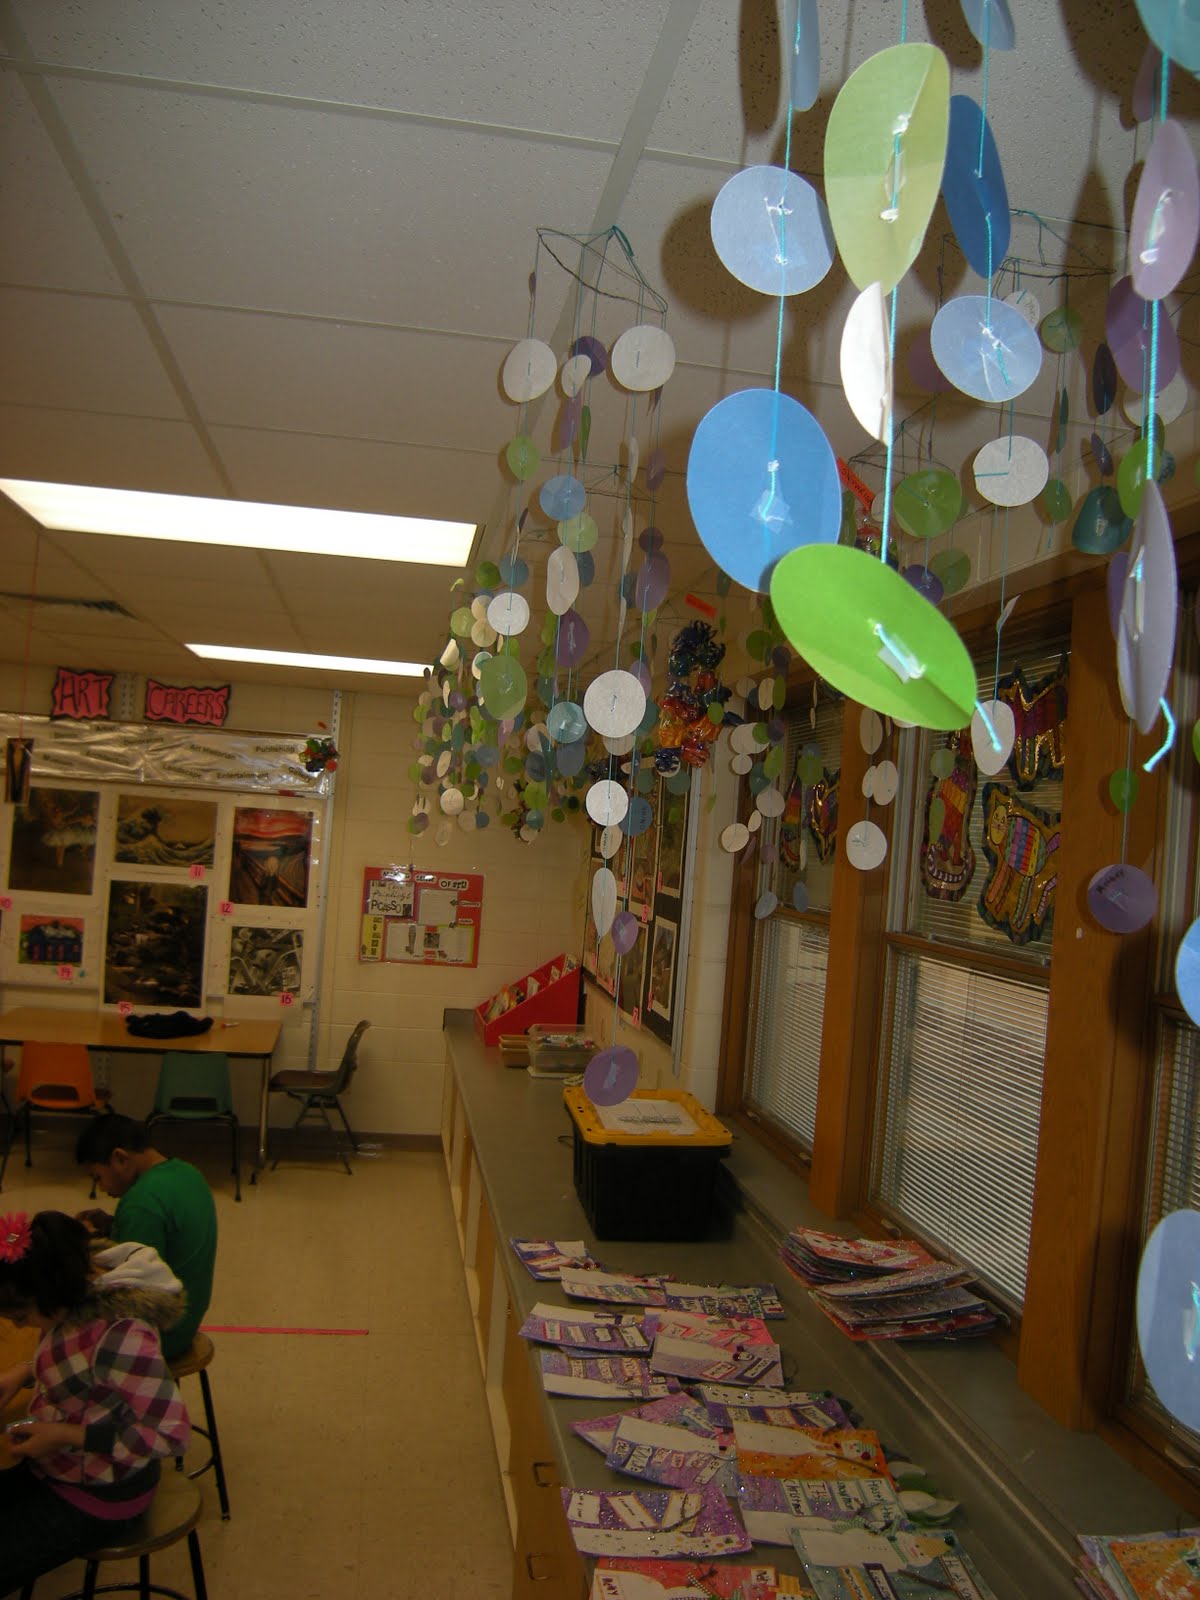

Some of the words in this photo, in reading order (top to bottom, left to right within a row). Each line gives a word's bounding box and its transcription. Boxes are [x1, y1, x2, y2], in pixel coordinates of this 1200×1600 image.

[60, 676, 108, 714] ART
[151, 687, 226, 720] CAREERS
[202, 746, 235, 760] Historian
[255, 746, 295, 755] Publishing
[163, 764, 202, 779] Landscape
[216, 772, 269, 780] Entertainment
[288, 766, 313, 783] Gallery
[441, 880, 452, 888] OF
[222, 904, 231, 914] 12
[281, 994, 292, 1005] 16
